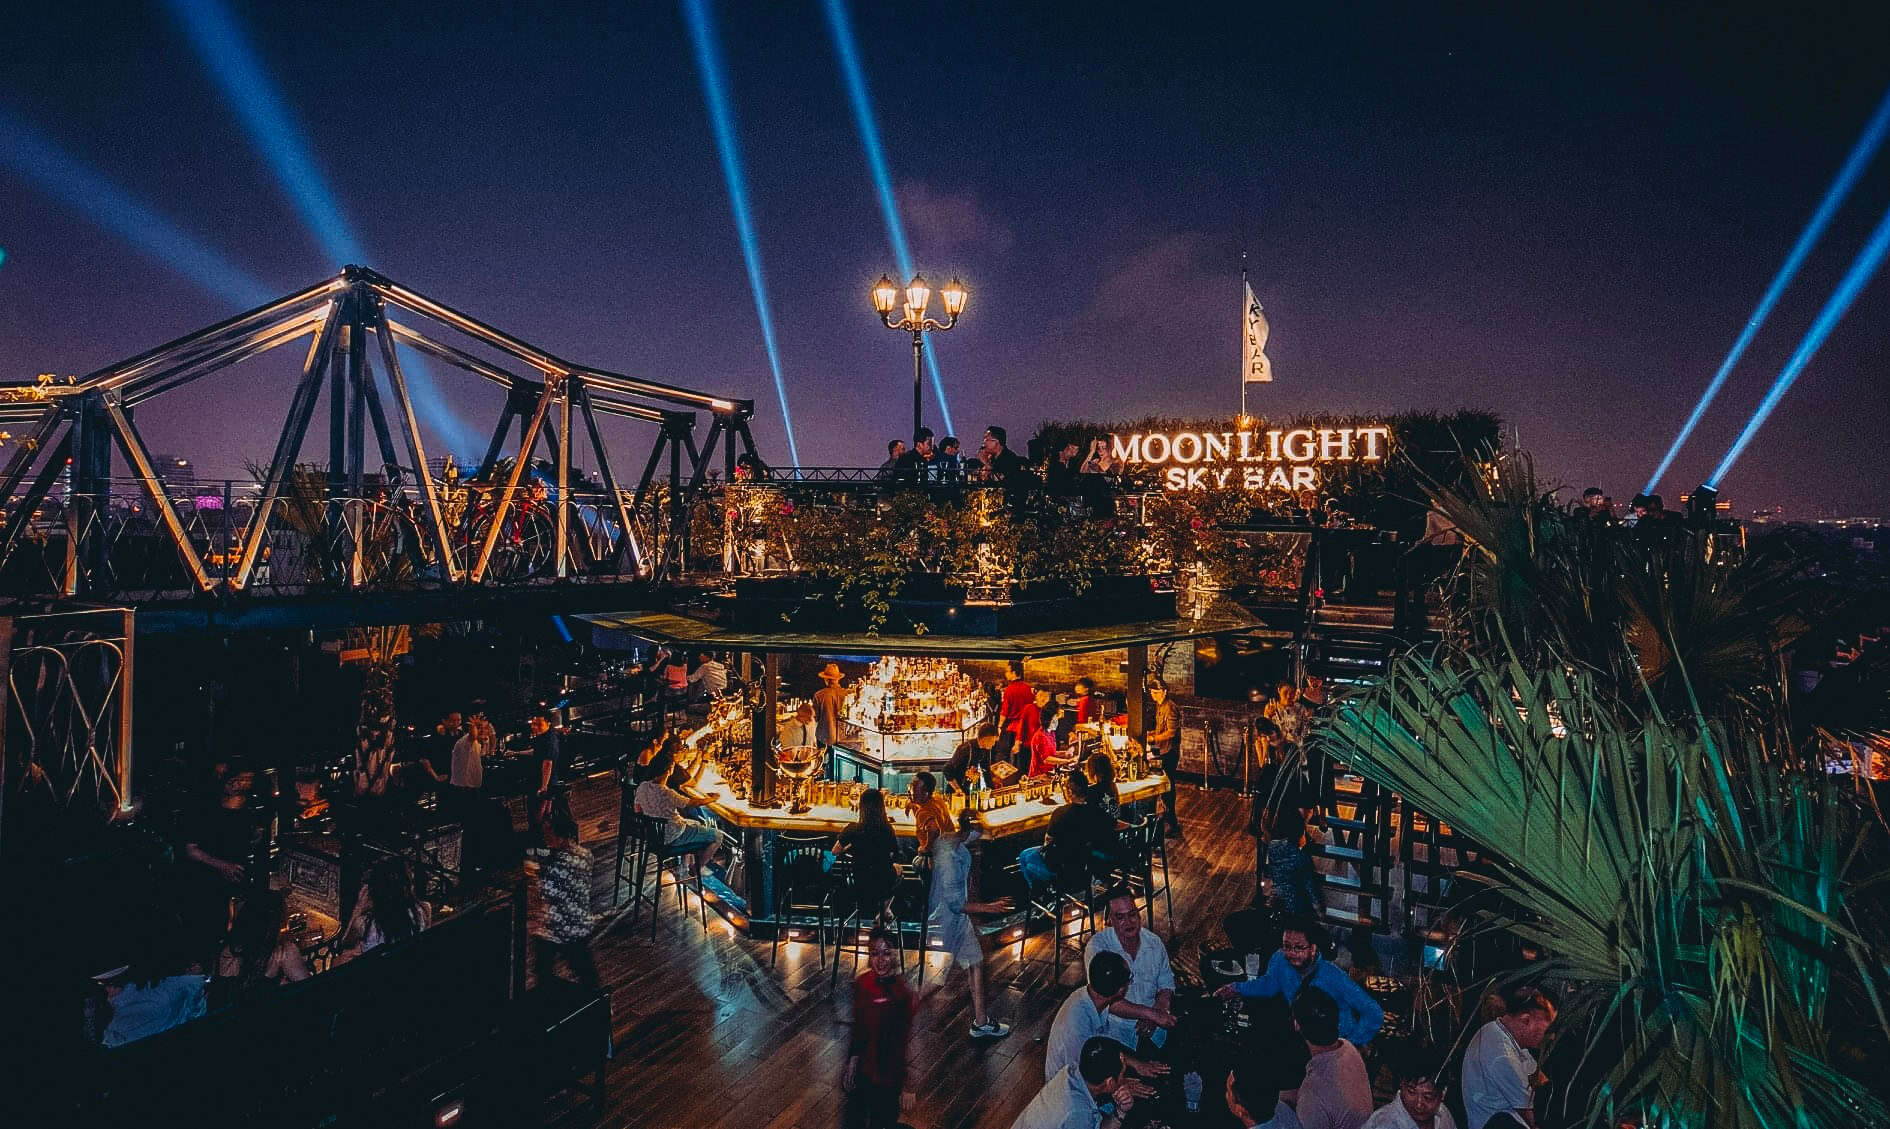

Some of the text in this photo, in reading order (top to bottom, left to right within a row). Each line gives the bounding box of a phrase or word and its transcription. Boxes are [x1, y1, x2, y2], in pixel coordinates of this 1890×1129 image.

[1112, 428, 1388, 463] MOONLIGHT
[1166, 466, 1317, 491] SKY BAR
